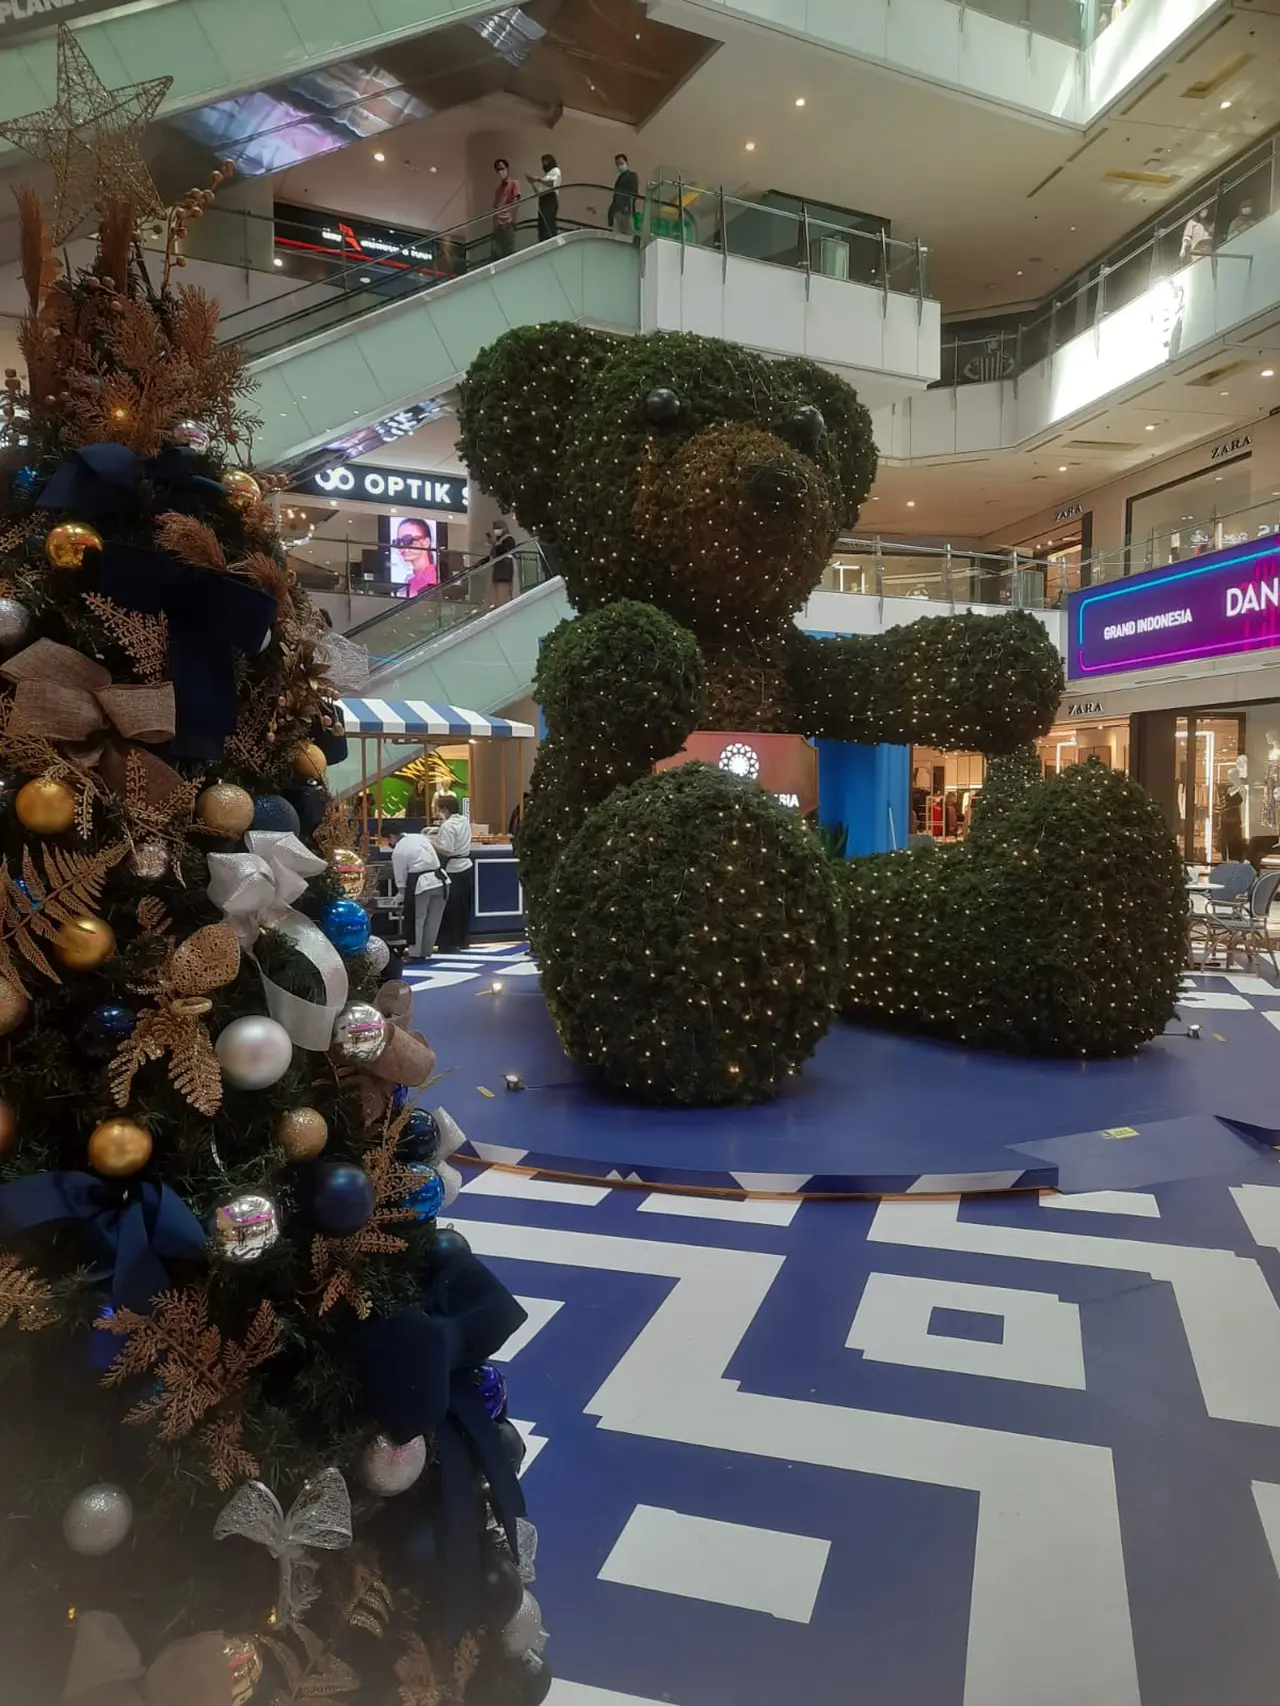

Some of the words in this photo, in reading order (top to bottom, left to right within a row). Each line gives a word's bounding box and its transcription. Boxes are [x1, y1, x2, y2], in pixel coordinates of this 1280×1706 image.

[0, 0, 84, 24] PLA
[1211, 435, 1252, 459] ZARA
[364, 473, 451, 504] OPTIK
[1052, 504, 1083, 522] ZARA
[1103, 620, 1136, 640] GRAND
[1137, 608, 1193, 633] INDONESIA
[1068, 703, 1104, 716] ZARA
